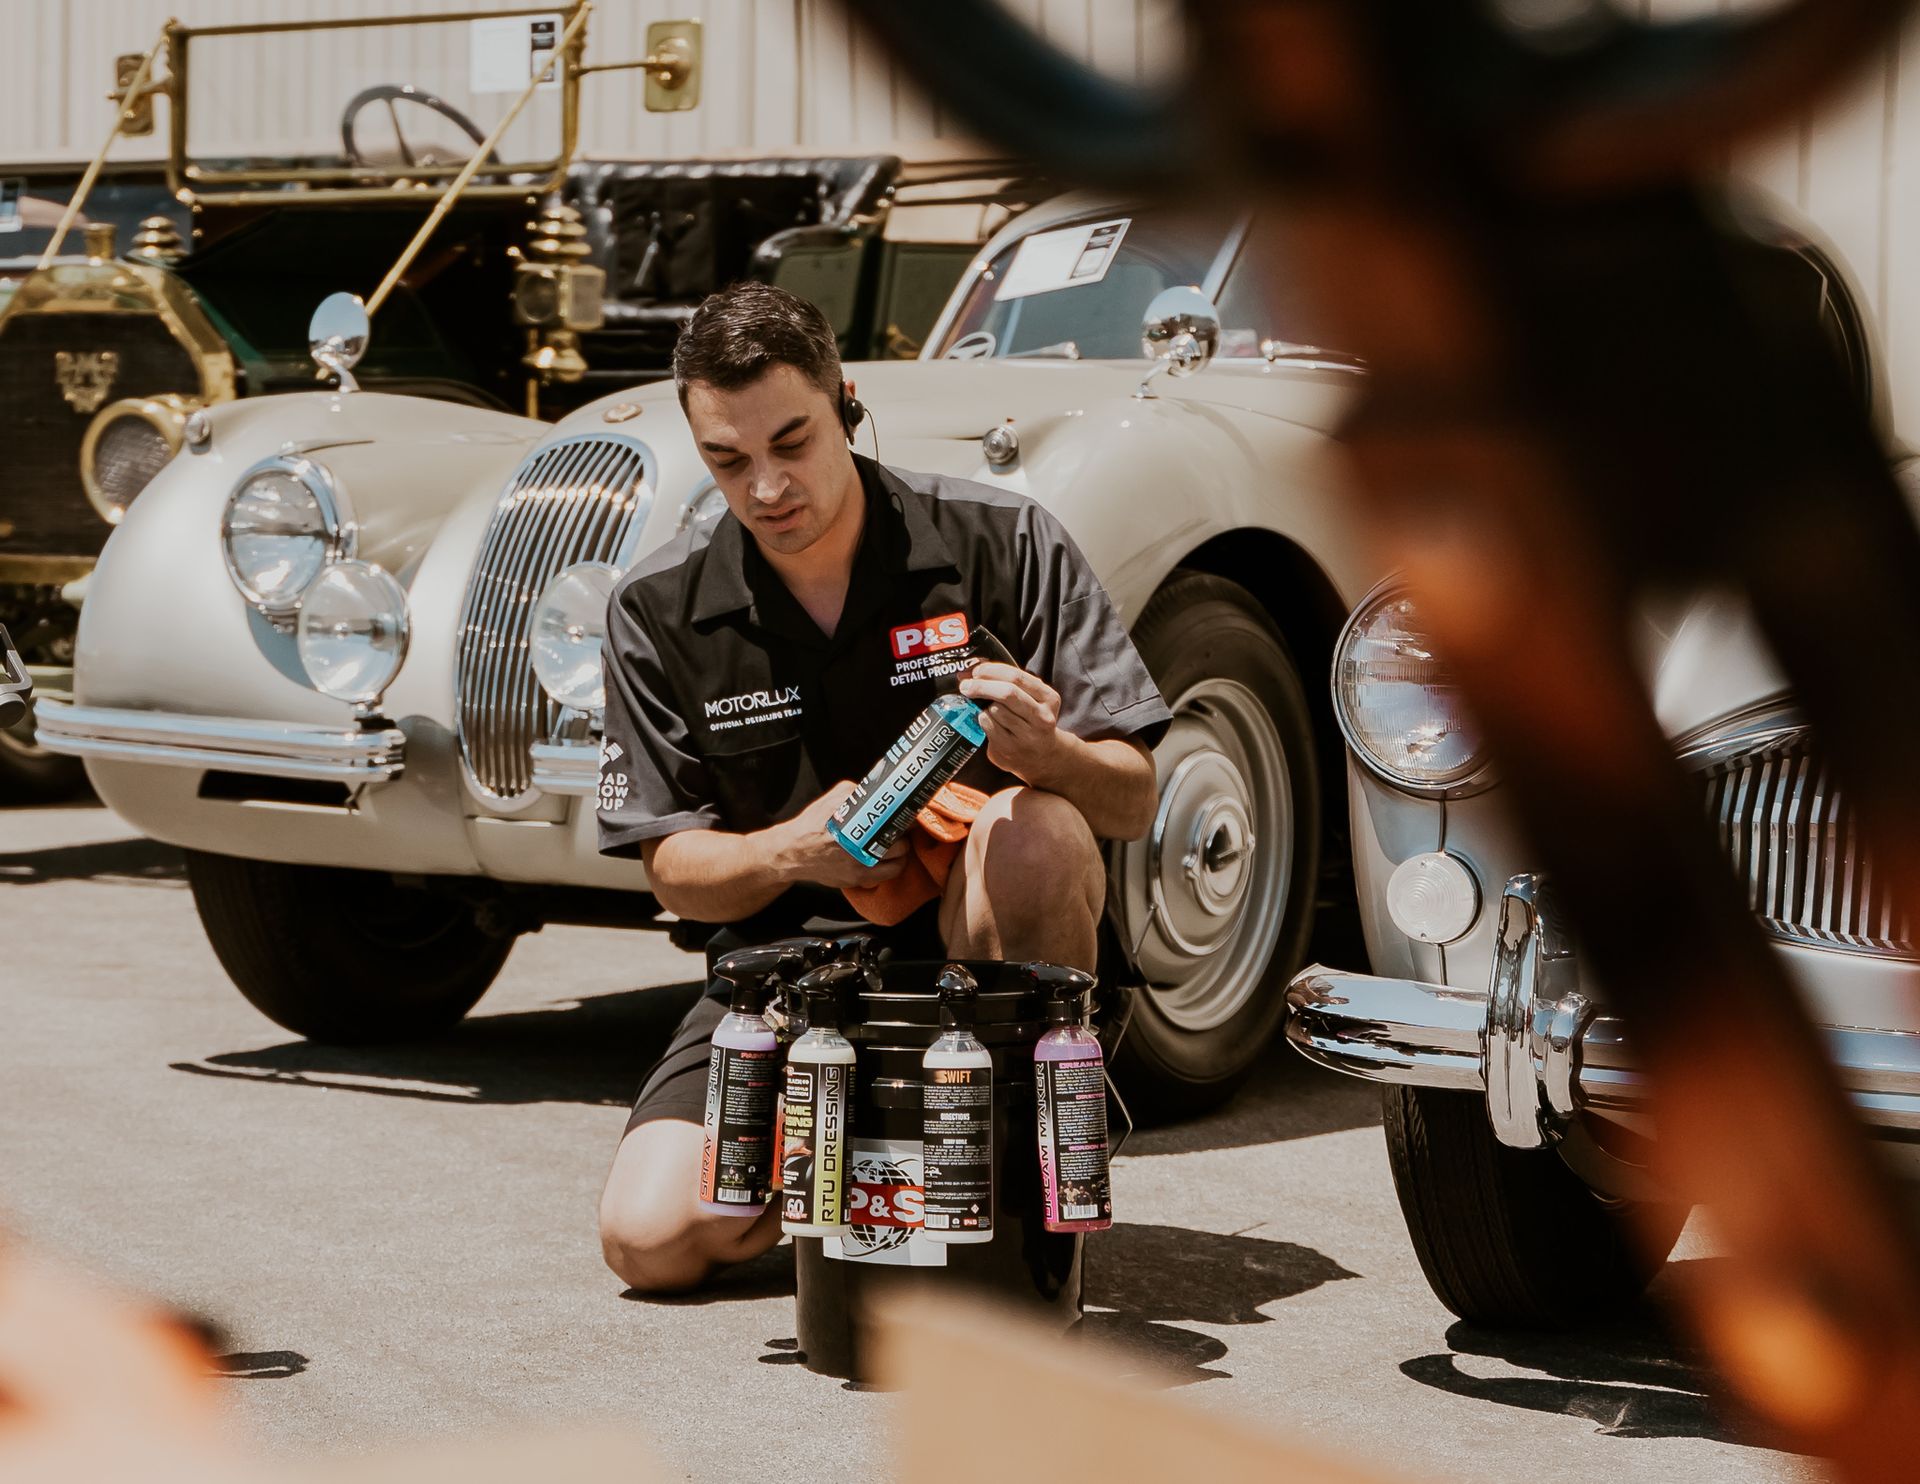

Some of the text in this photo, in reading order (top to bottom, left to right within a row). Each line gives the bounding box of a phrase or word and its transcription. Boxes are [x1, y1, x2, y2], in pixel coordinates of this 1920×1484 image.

[895, 617, 965, 656] P&S
[890, 657, 976, 687] DETAIL PRODUC
[896, 647, 970, 674] PROFESS
[704, 685, 801, 718] MOTORLUX
[710, 707, 803, 732] OFFICIAL DETAILING TEAM
[598, 784, 629, 799] OW
[849, 791, 896, 842] GLASS
[892, 724, 956, 793] CLEANER
[934, 1069, 972, 1084] SWIFT
[701, 1047, 721, 1197] SPRAY N SHINE
[821, 1066, 840, 1223] RTU DRESSING
[1036, 1062, 1053, 1219] DREAM MAKER
